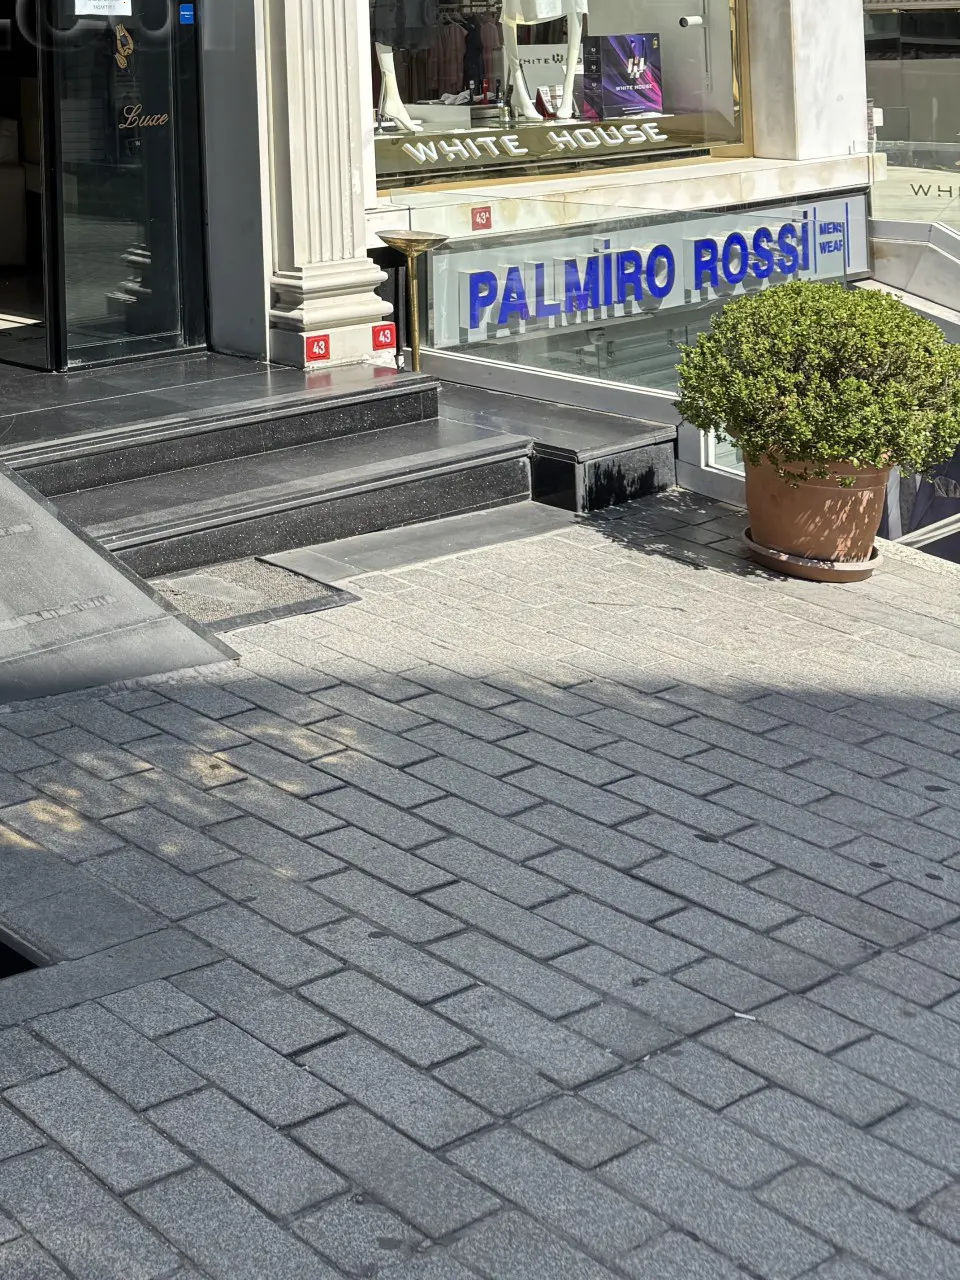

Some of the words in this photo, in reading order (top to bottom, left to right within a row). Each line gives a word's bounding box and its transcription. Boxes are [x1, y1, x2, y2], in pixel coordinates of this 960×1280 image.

[118, 103, 169, 129] Luxe
[401, 134, 529, 165] WHITE
[546, 122, 669, 152] HOUSE
[378, 330, 391, 343] 43
[312, 341, 326, 355] 43
